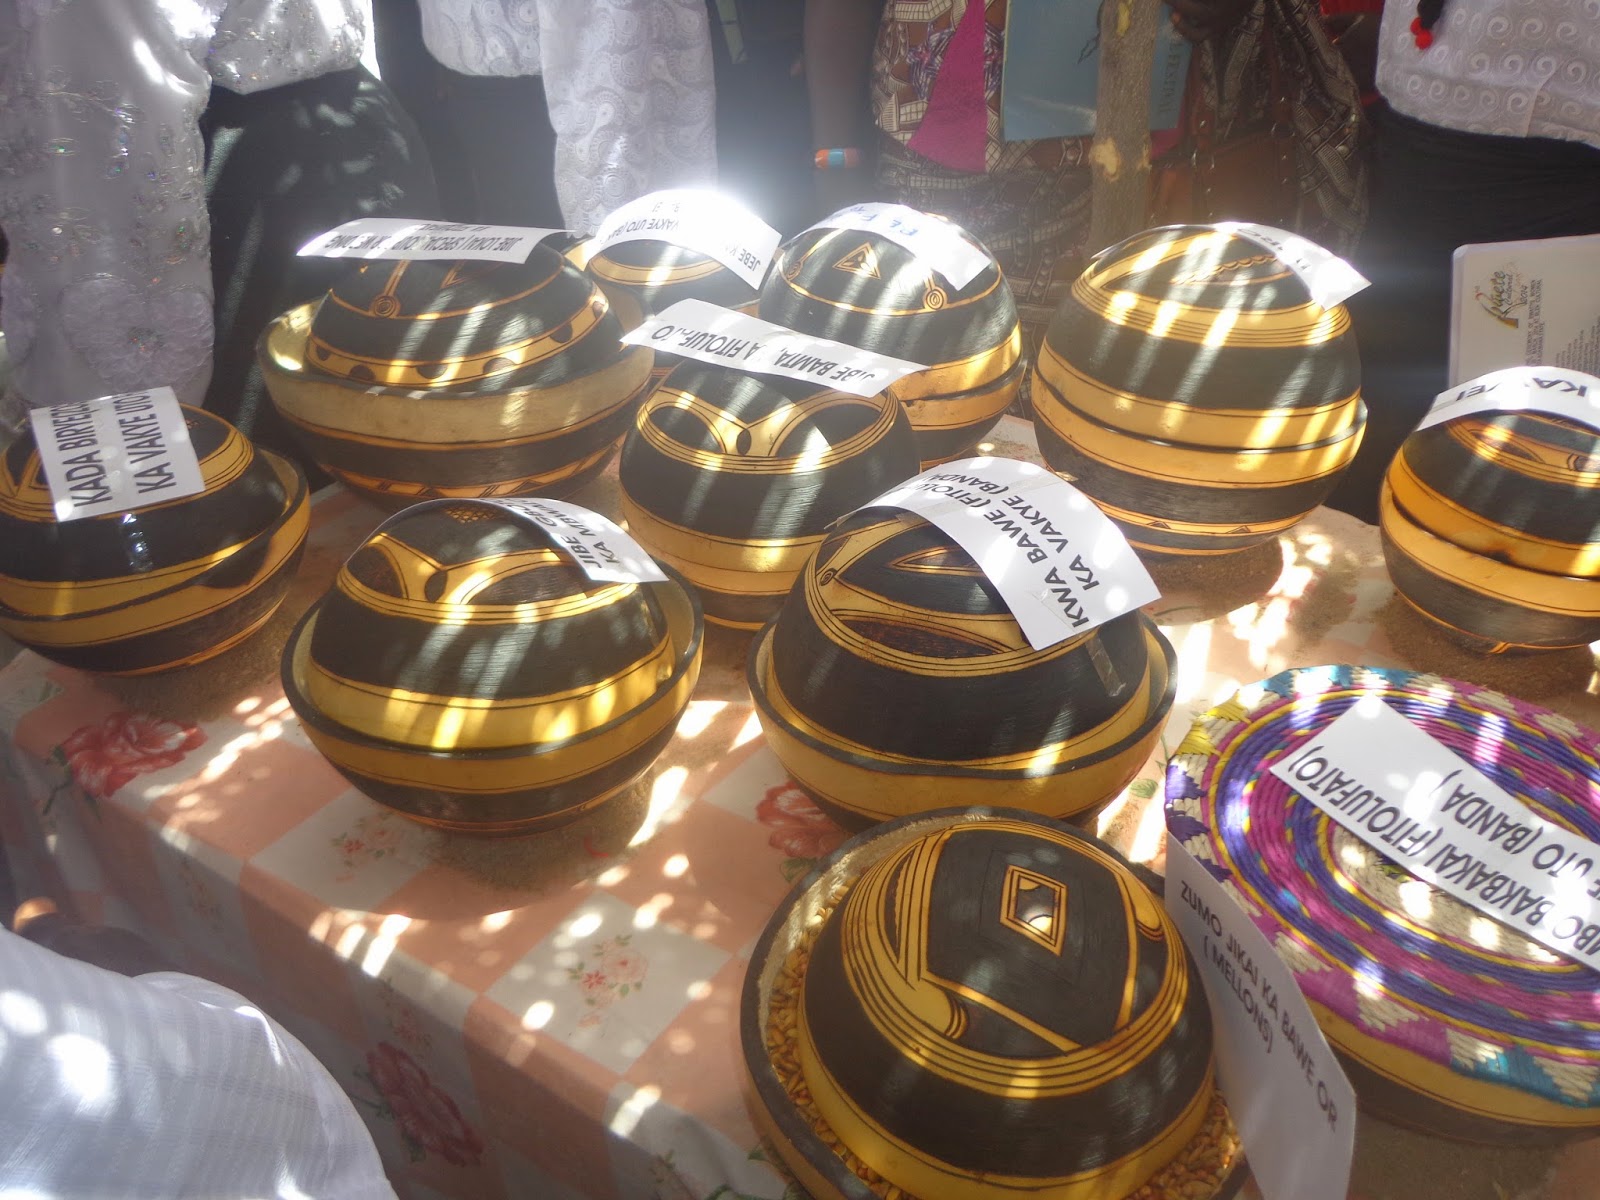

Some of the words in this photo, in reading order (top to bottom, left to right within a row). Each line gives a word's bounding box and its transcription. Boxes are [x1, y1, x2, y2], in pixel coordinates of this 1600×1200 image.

[626, 219, 647, 233] UTO
[118, 413, 167, 464] VAKYE
[62, 449, 113, 507] KADA
[134, 462, 177, 493] KA
[983, 511, 1048, 565] BAWE
[1002, 495, 1069, 554] VAKYE
[561, 536, 602, 569] JIBE
[593, 541, 620, 564] KA
[1070, 554, 1100, 591] KA
[1044, 566, 1089, 628] KWA
[1288, 746, 1444, 857] (FITOLUFATO)
[1425, 843, 1555, 927] BAKBAKAI
[1180, 880, 1223, 937] ZUMO
[1226, 935, 1259, 986] JIKAI
[1262, 977, 1279, 1020] KA
[1281, 1009, 1315, 1087] BAWE
[1317, 1081, 1338, 1132] OR
